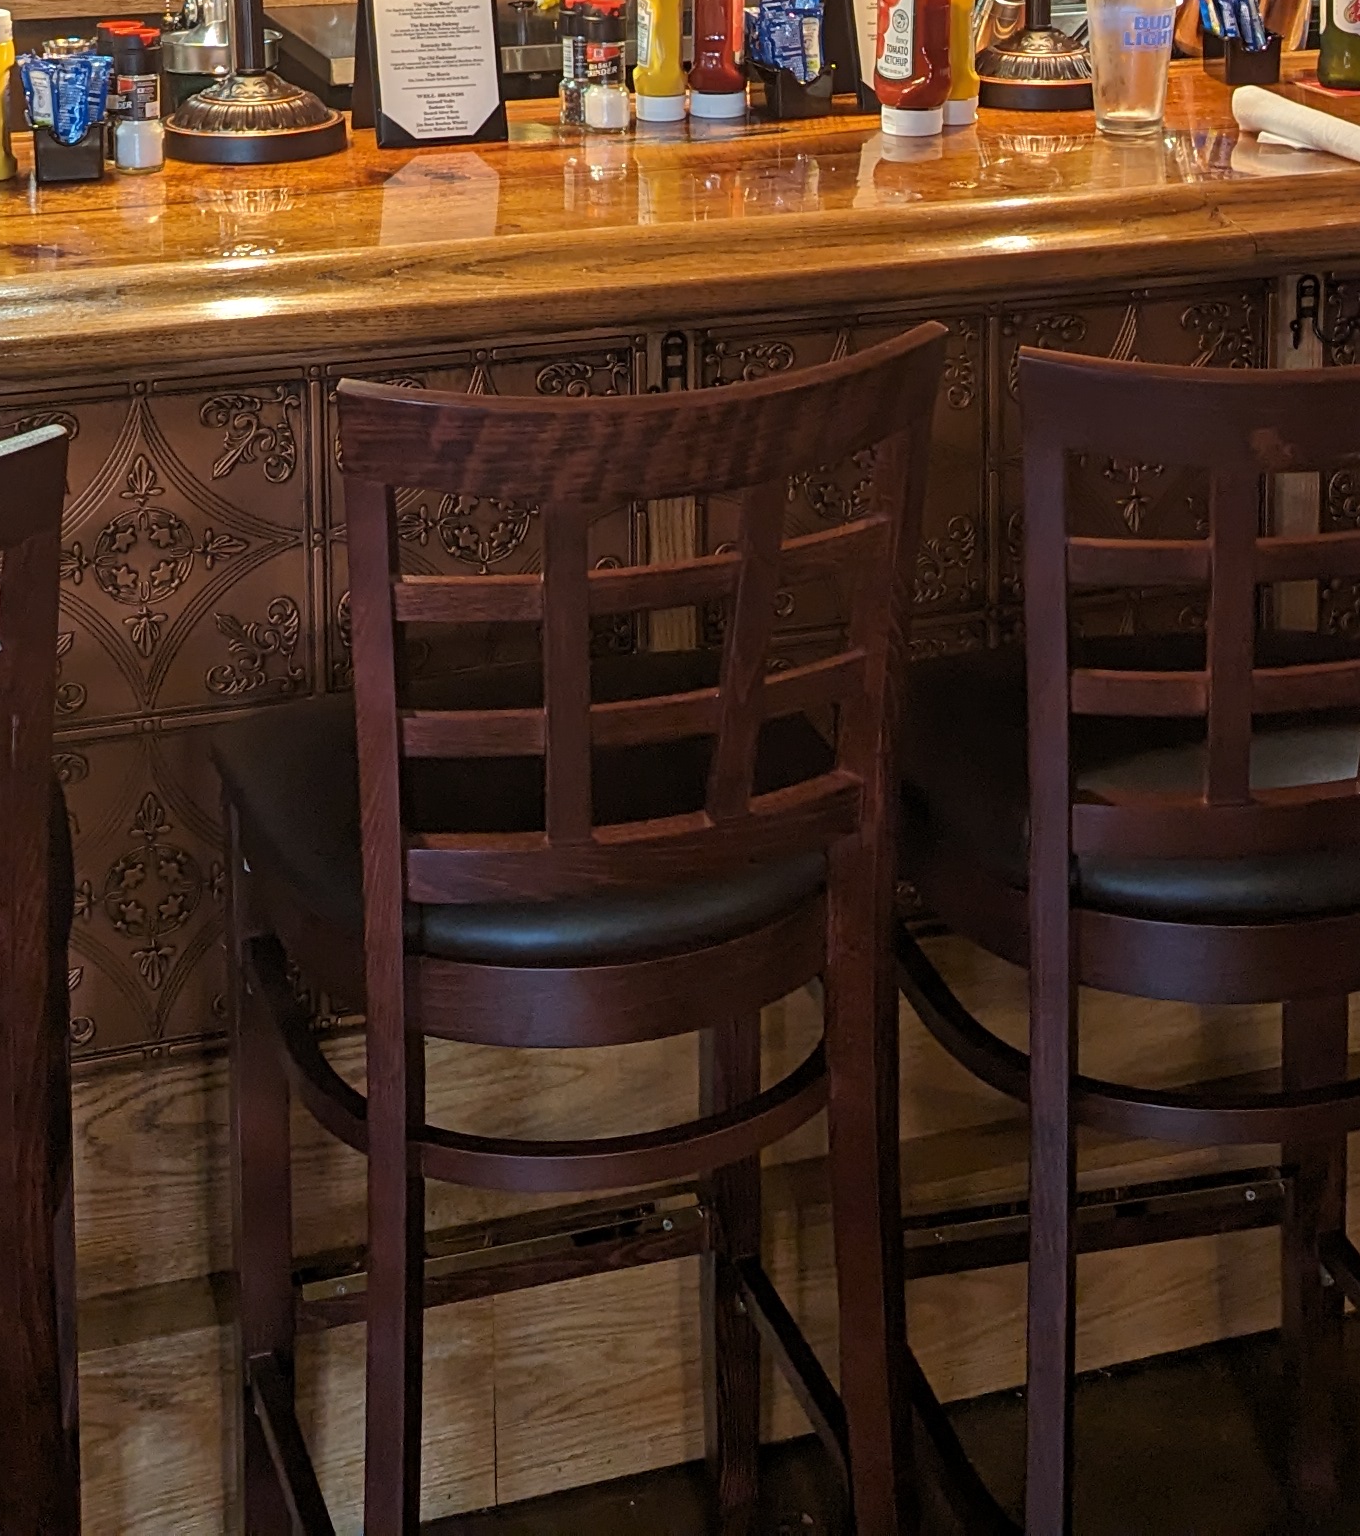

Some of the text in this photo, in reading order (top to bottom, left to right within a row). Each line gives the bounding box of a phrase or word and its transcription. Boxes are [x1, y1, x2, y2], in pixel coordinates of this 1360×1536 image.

[1134, 15, 1172, 29] BUD
[886, 43, 909, 56] TOMATO
[884, 55, 909, 66] KETCHUP
